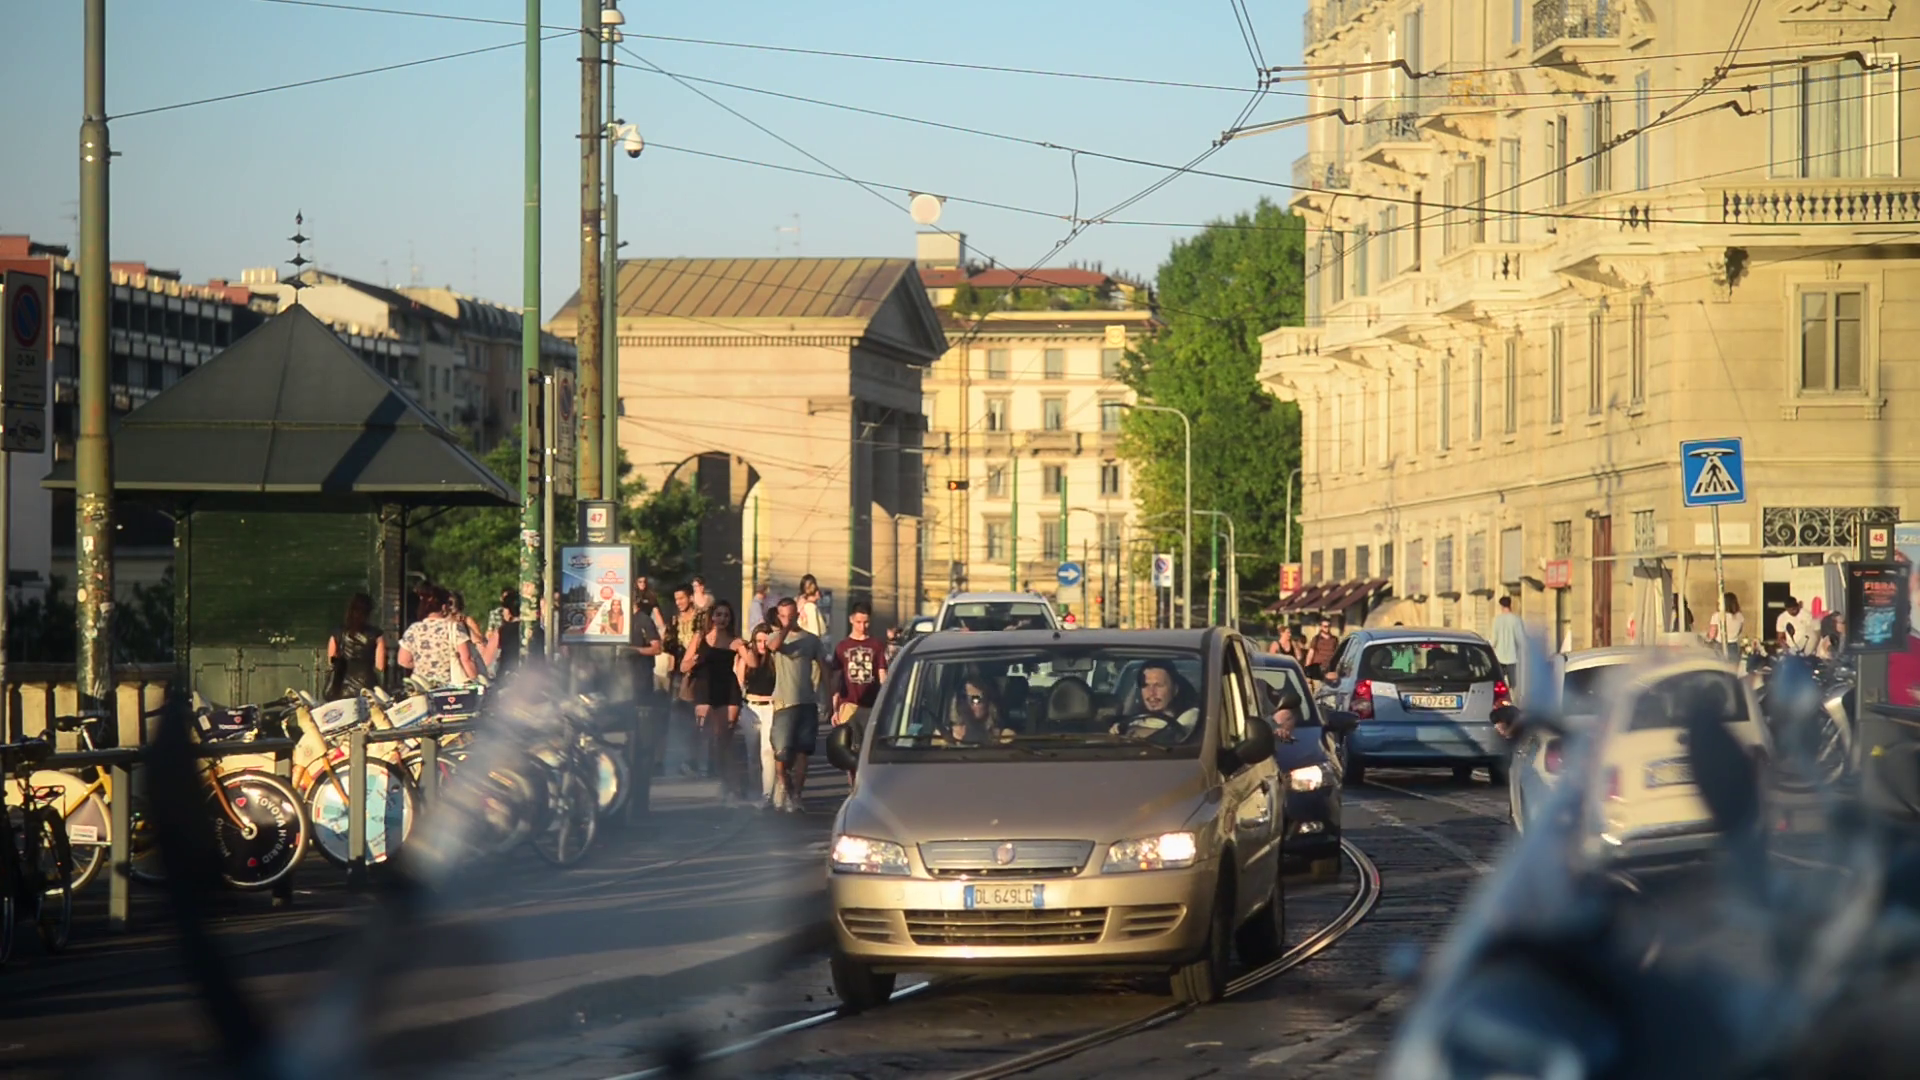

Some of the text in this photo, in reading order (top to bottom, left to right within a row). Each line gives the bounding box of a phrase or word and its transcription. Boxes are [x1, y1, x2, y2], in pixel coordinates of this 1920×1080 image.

[590, 513, 603, 522] 47
[1873, 533, 1884, 542] 48
[254, 796, 287, 864] TOYOTA HYBRID
[975, 888, 1033, 904] DL 649LD
